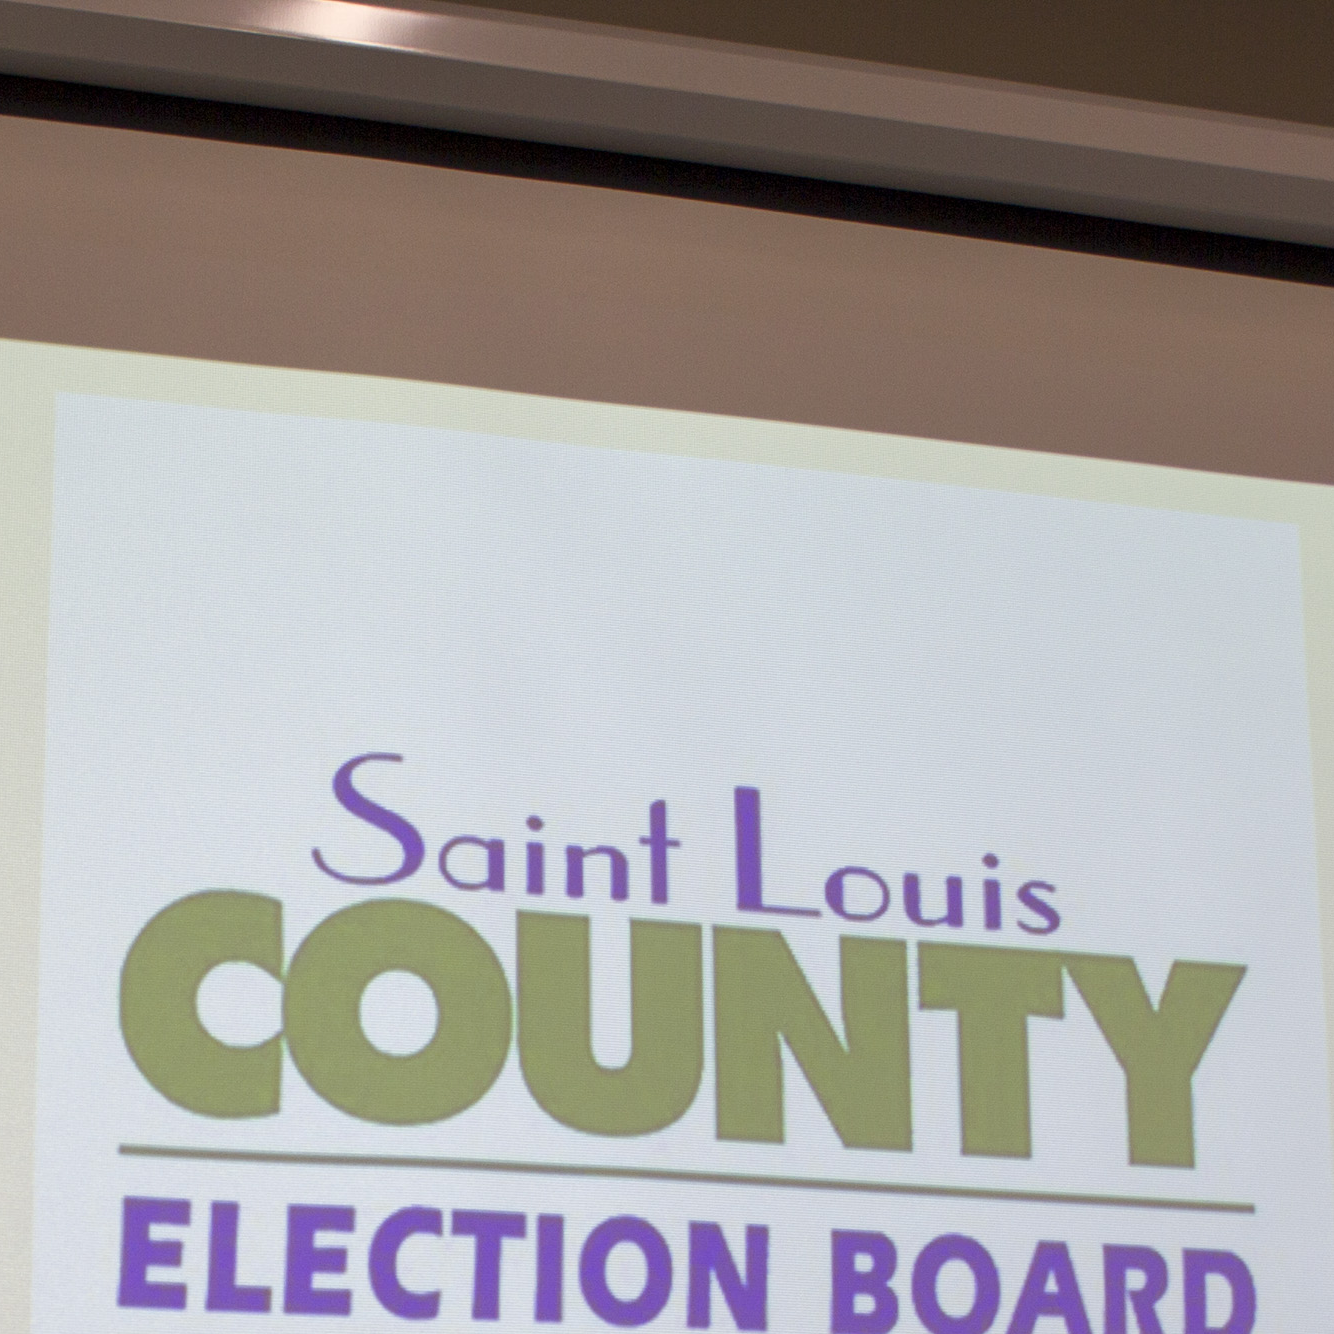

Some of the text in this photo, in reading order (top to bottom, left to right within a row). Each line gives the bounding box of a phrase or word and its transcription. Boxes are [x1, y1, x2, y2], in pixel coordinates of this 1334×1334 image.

[310, 752, 1062, 936] Saint Louis
[118, 888, 1249, 1169] COUNTY
[117, 1196, 770, 1333] ELECTION
